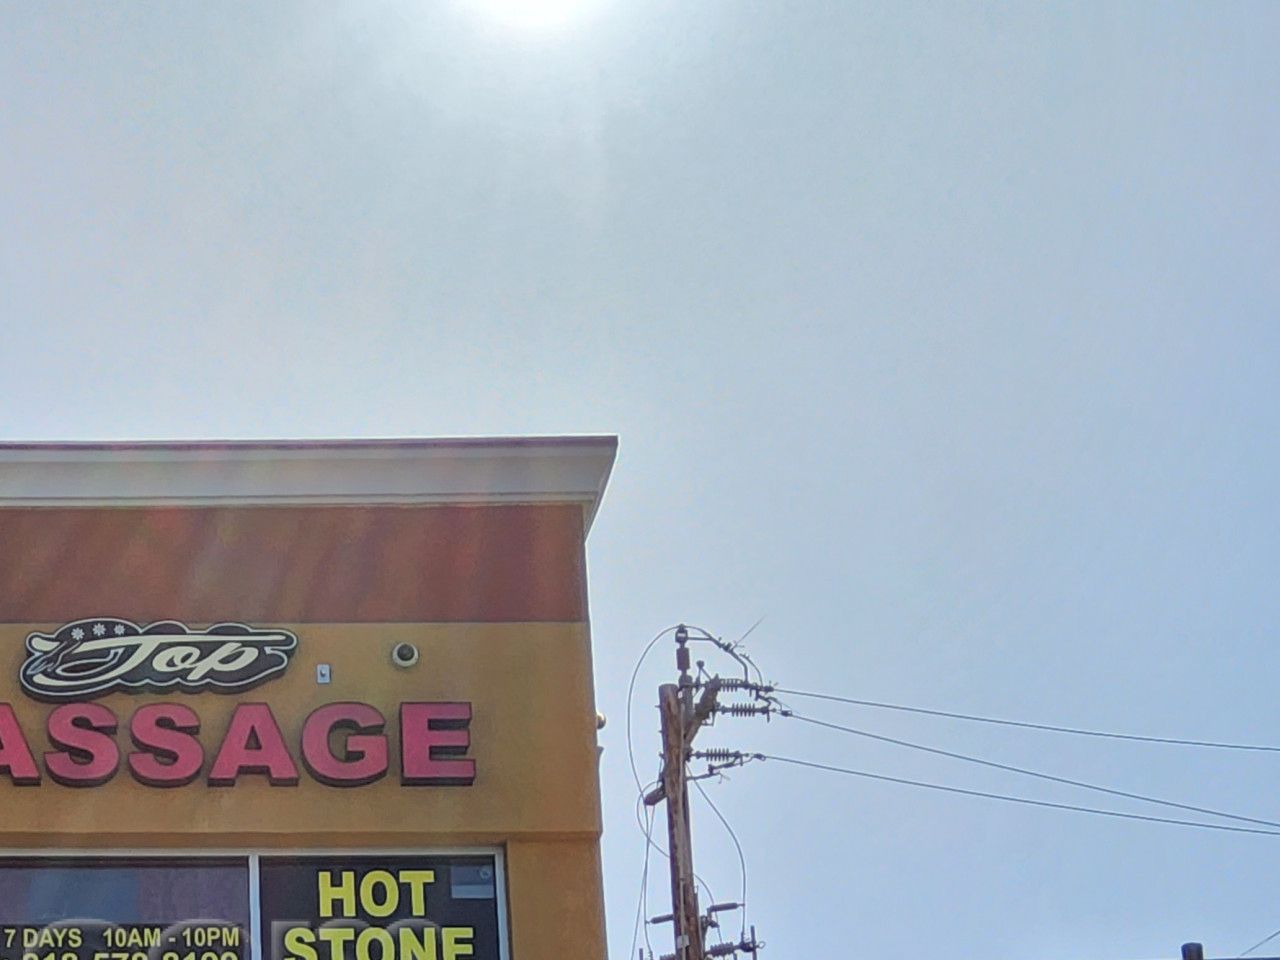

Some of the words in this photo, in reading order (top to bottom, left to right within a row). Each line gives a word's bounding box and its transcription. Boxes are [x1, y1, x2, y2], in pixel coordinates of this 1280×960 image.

[31, 633, 287, 687] Top
[318, 870, 435, 918] HOT
[4, 928, 16, 947] 7
[23, 928, 83, 948] DAYS
[103, 928, 161, 947] 10AM
[182, 927, 239, 947] 10PM
